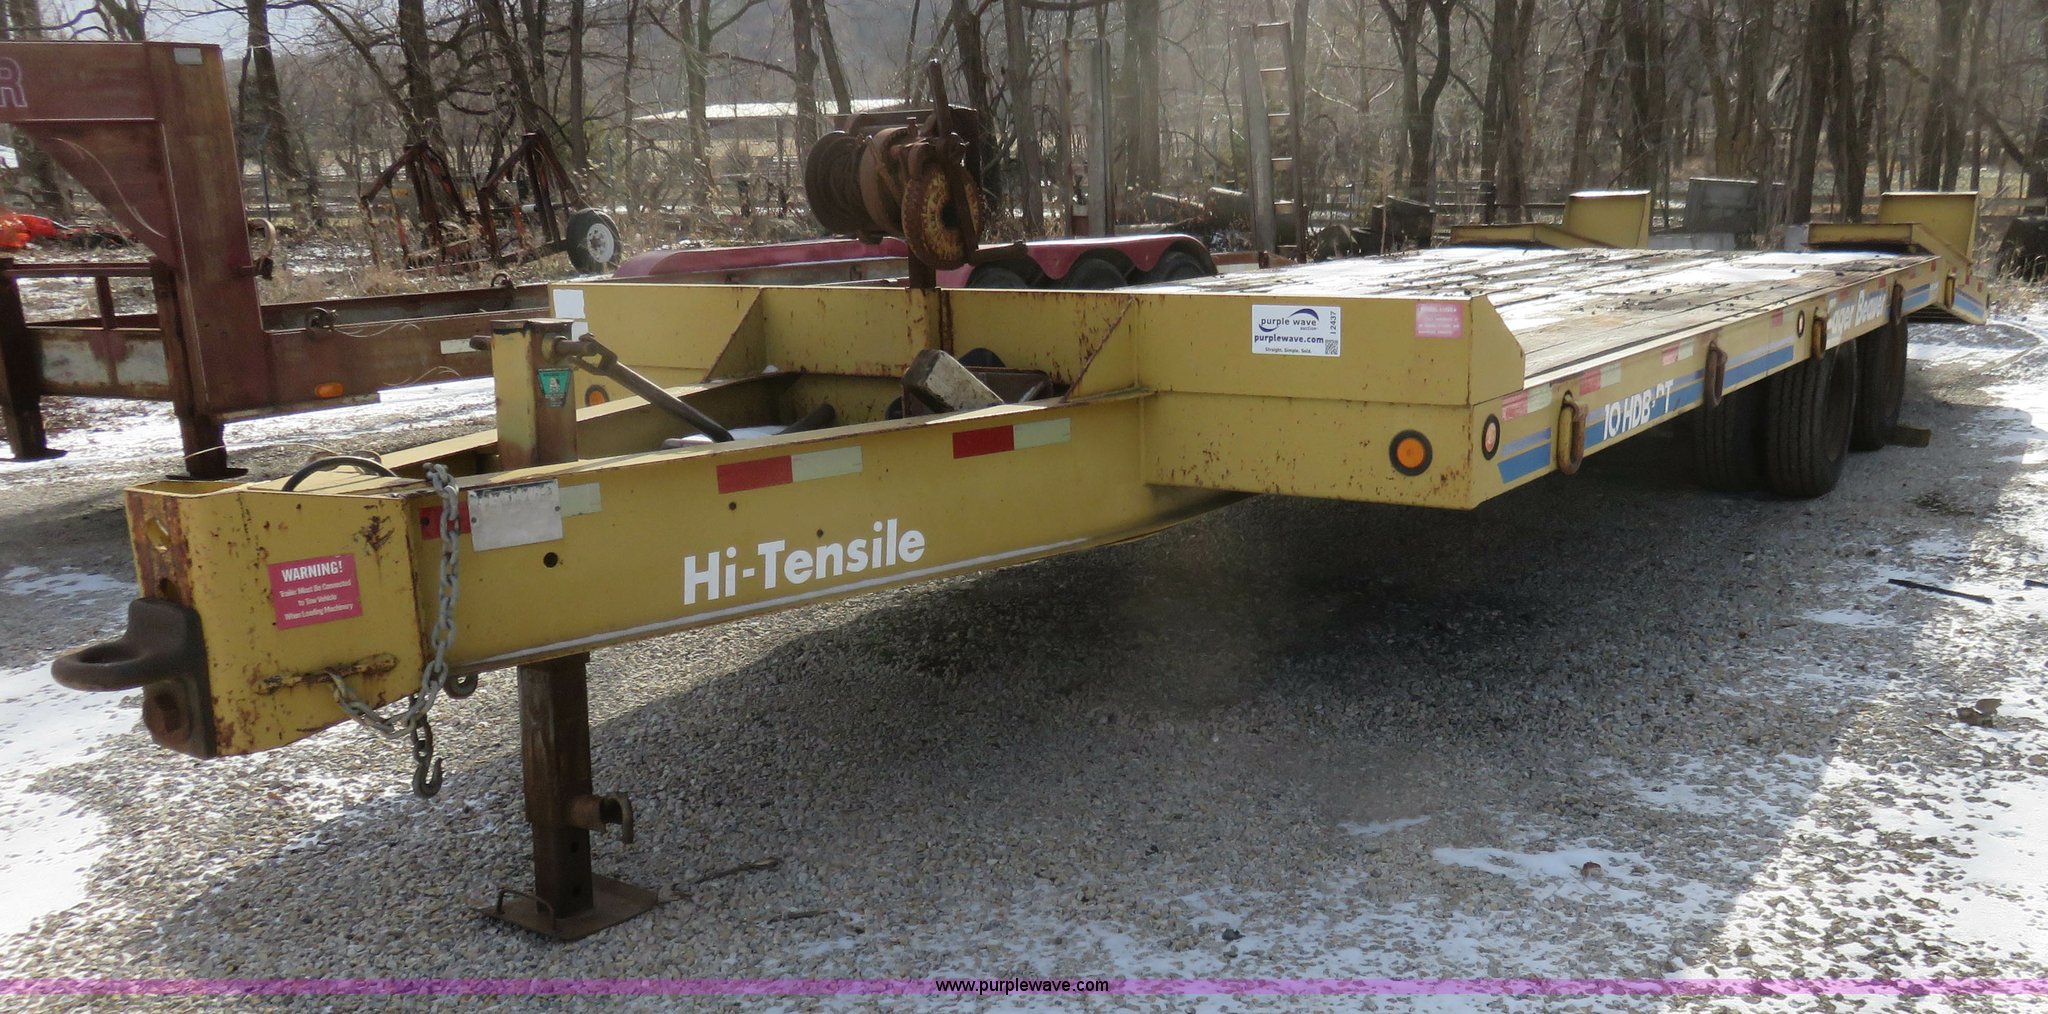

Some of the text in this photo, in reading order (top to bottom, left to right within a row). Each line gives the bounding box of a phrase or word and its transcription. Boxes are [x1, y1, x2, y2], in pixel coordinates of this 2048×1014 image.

[1261, 317, 1317, 328] purple wave
[1254, 334, 1324, 344] purplewave.com
[1603, 401, 1621, 441] 10
[683, 518, 926, 605] Hi-Tensile
[281, 561, 343, 582] WARNING!
[279, 579, 352, 598] Trailer Must Be Connected
[297, 594, 337, 607] to Tow Vehicle
[284, 603, 353, 621] When Loading Machinery
